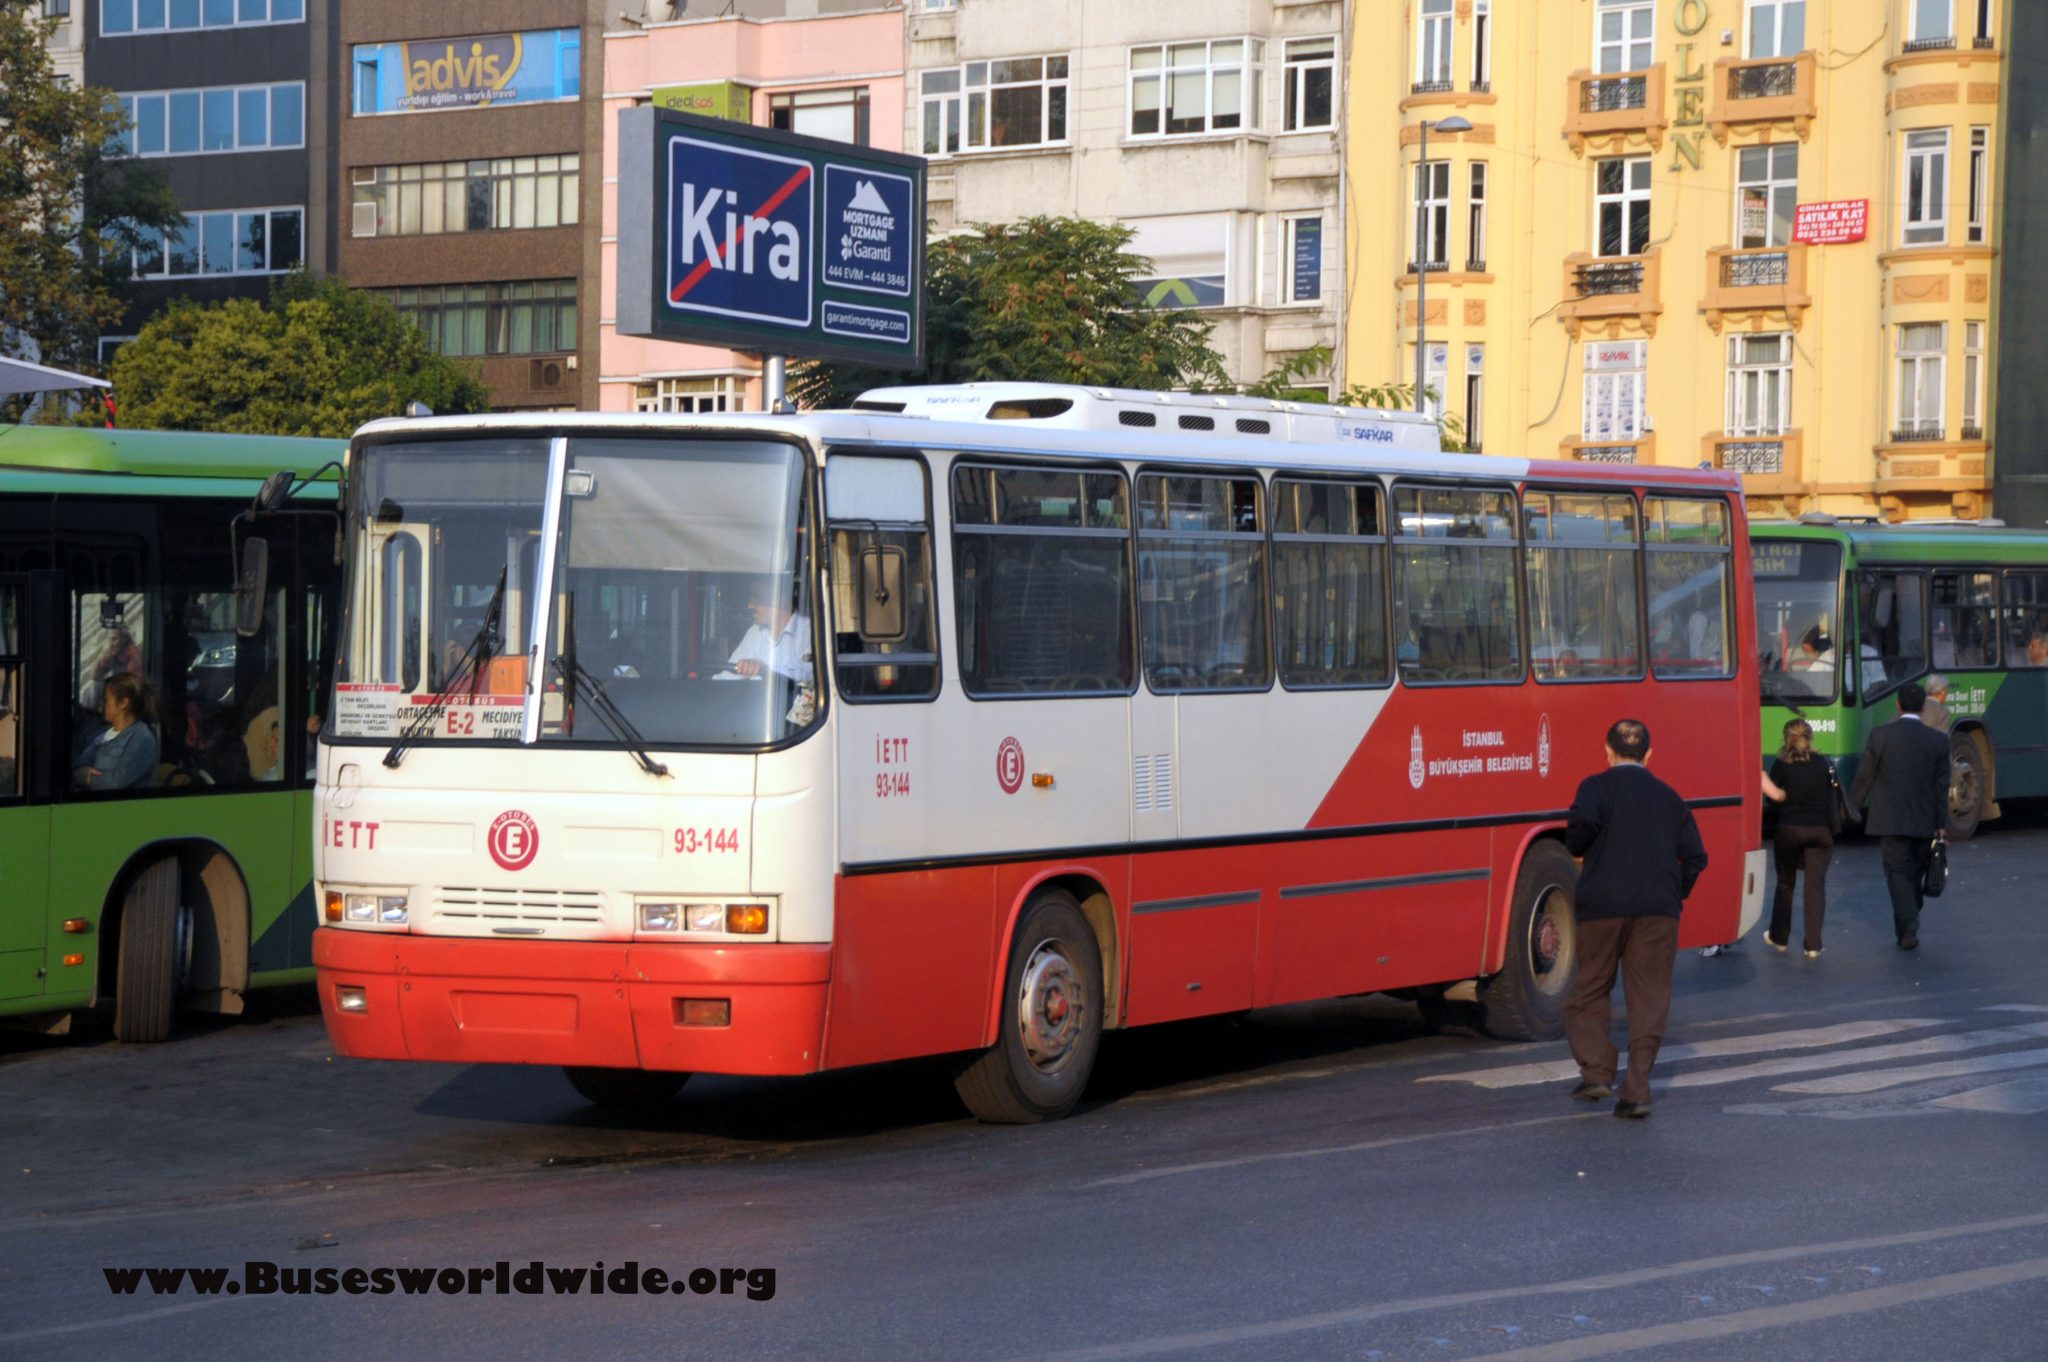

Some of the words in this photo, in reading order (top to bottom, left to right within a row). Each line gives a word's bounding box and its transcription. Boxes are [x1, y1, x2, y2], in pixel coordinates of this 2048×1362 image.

[412, 43, 501, 91] advis
[430, 91, 458, 105] eğitim
[464, 88, 517, 101] work&travel
[843, 210, 895, 230] MORTGAGE
[1798, 211, 1838, 223] SATILIK
[1841, 208, 1865, 220] KAT
[682, 182, 799, 282] Kira
[850, 225, 887, 242] UZMANI
[853, 240, 891, 262] Garanti
[828, 265, 843, 277] 444
[870, 271, 885, 284] 444
[886, 273, 906, 287] 3846
[827, 312, 905, 331] garantimortgage.com
[1353, 427, 1393, 442] SAFKAR
[447, 711, 474, 735] E-2
[876, 732, 908, 763] İETT
[1463, 729, 1504, 747] İSTANBUL
[1429, 756, 1483, 778] BÜYÜKŞEHİR
[1487, 753, 1533, 772] BELEDİYESİ
[876, 772, 909, 797] 93-144
[325, 812, 379, 849] İETT
[506, 826, 522, 855] E
[675, 828, 739, 853] 93-144
